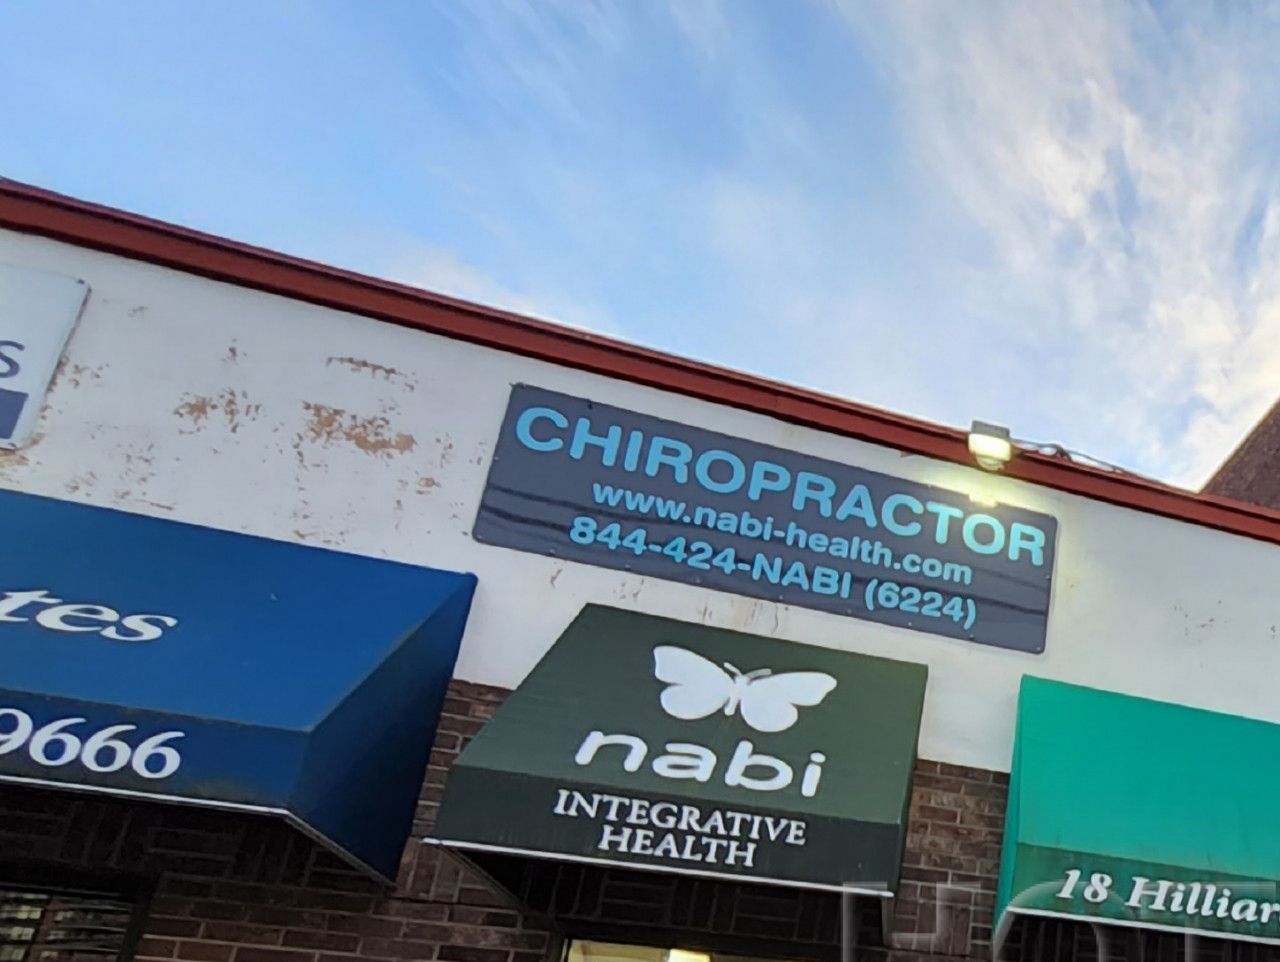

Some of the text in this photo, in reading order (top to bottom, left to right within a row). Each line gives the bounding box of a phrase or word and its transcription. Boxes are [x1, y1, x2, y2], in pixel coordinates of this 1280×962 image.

[514, 406, 1047, 566] CHIROPRACTOR
[592, 482, 973, 585] www.nabi-health.com
[569, 516, 977, 629] 844-424-NABI (6224)
[574, 730, 827, 797] nabi
[553, 789, 807, 846] INTEGRATIVE
[597, 824, 757, 868] HEALTH
[1056, 868, 1113, 903] 18
